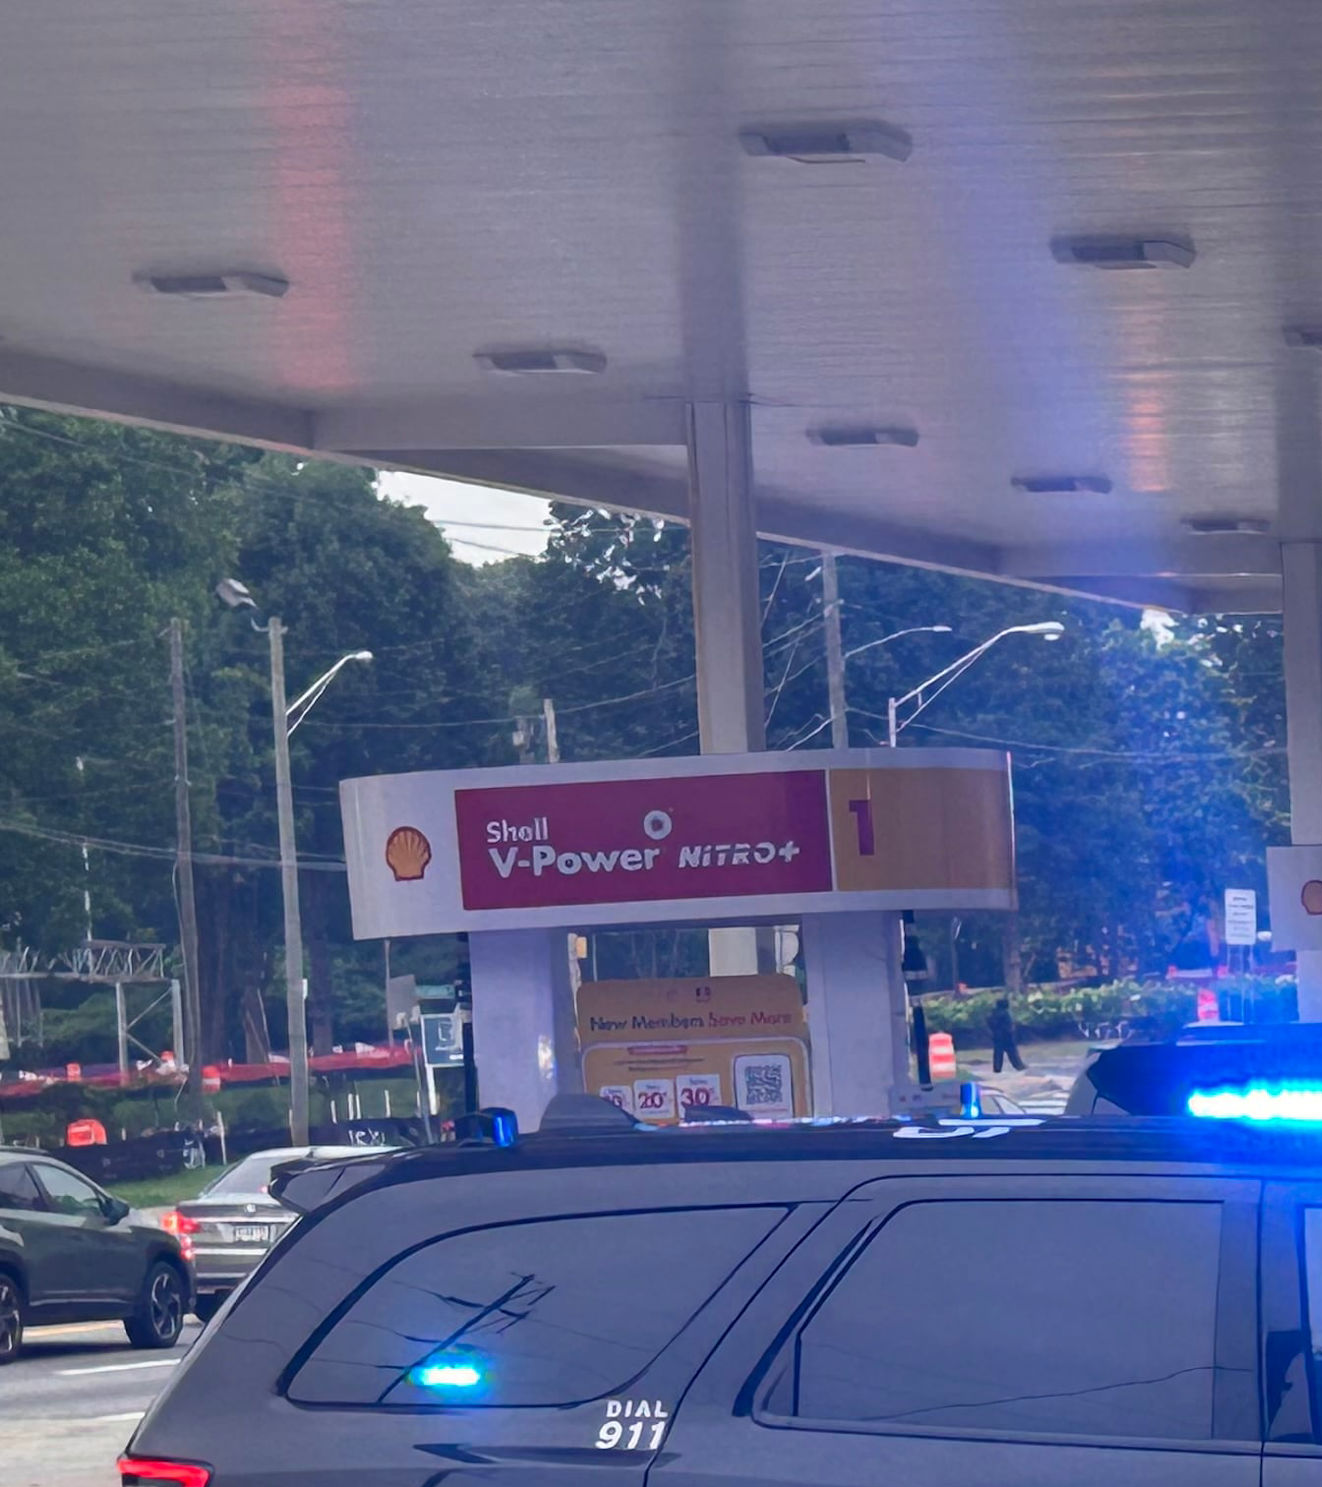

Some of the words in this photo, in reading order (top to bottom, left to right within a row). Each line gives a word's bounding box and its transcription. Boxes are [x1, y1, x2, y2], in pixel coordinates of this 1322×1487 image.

[486, 816, 549, 844] Shell
[848, 800, 875, 857] 1
[488, 845, 661, 879] V-Power
[606, 1400, 668, 1418] DIAL
[595, 1420, 665, 1450] 911
